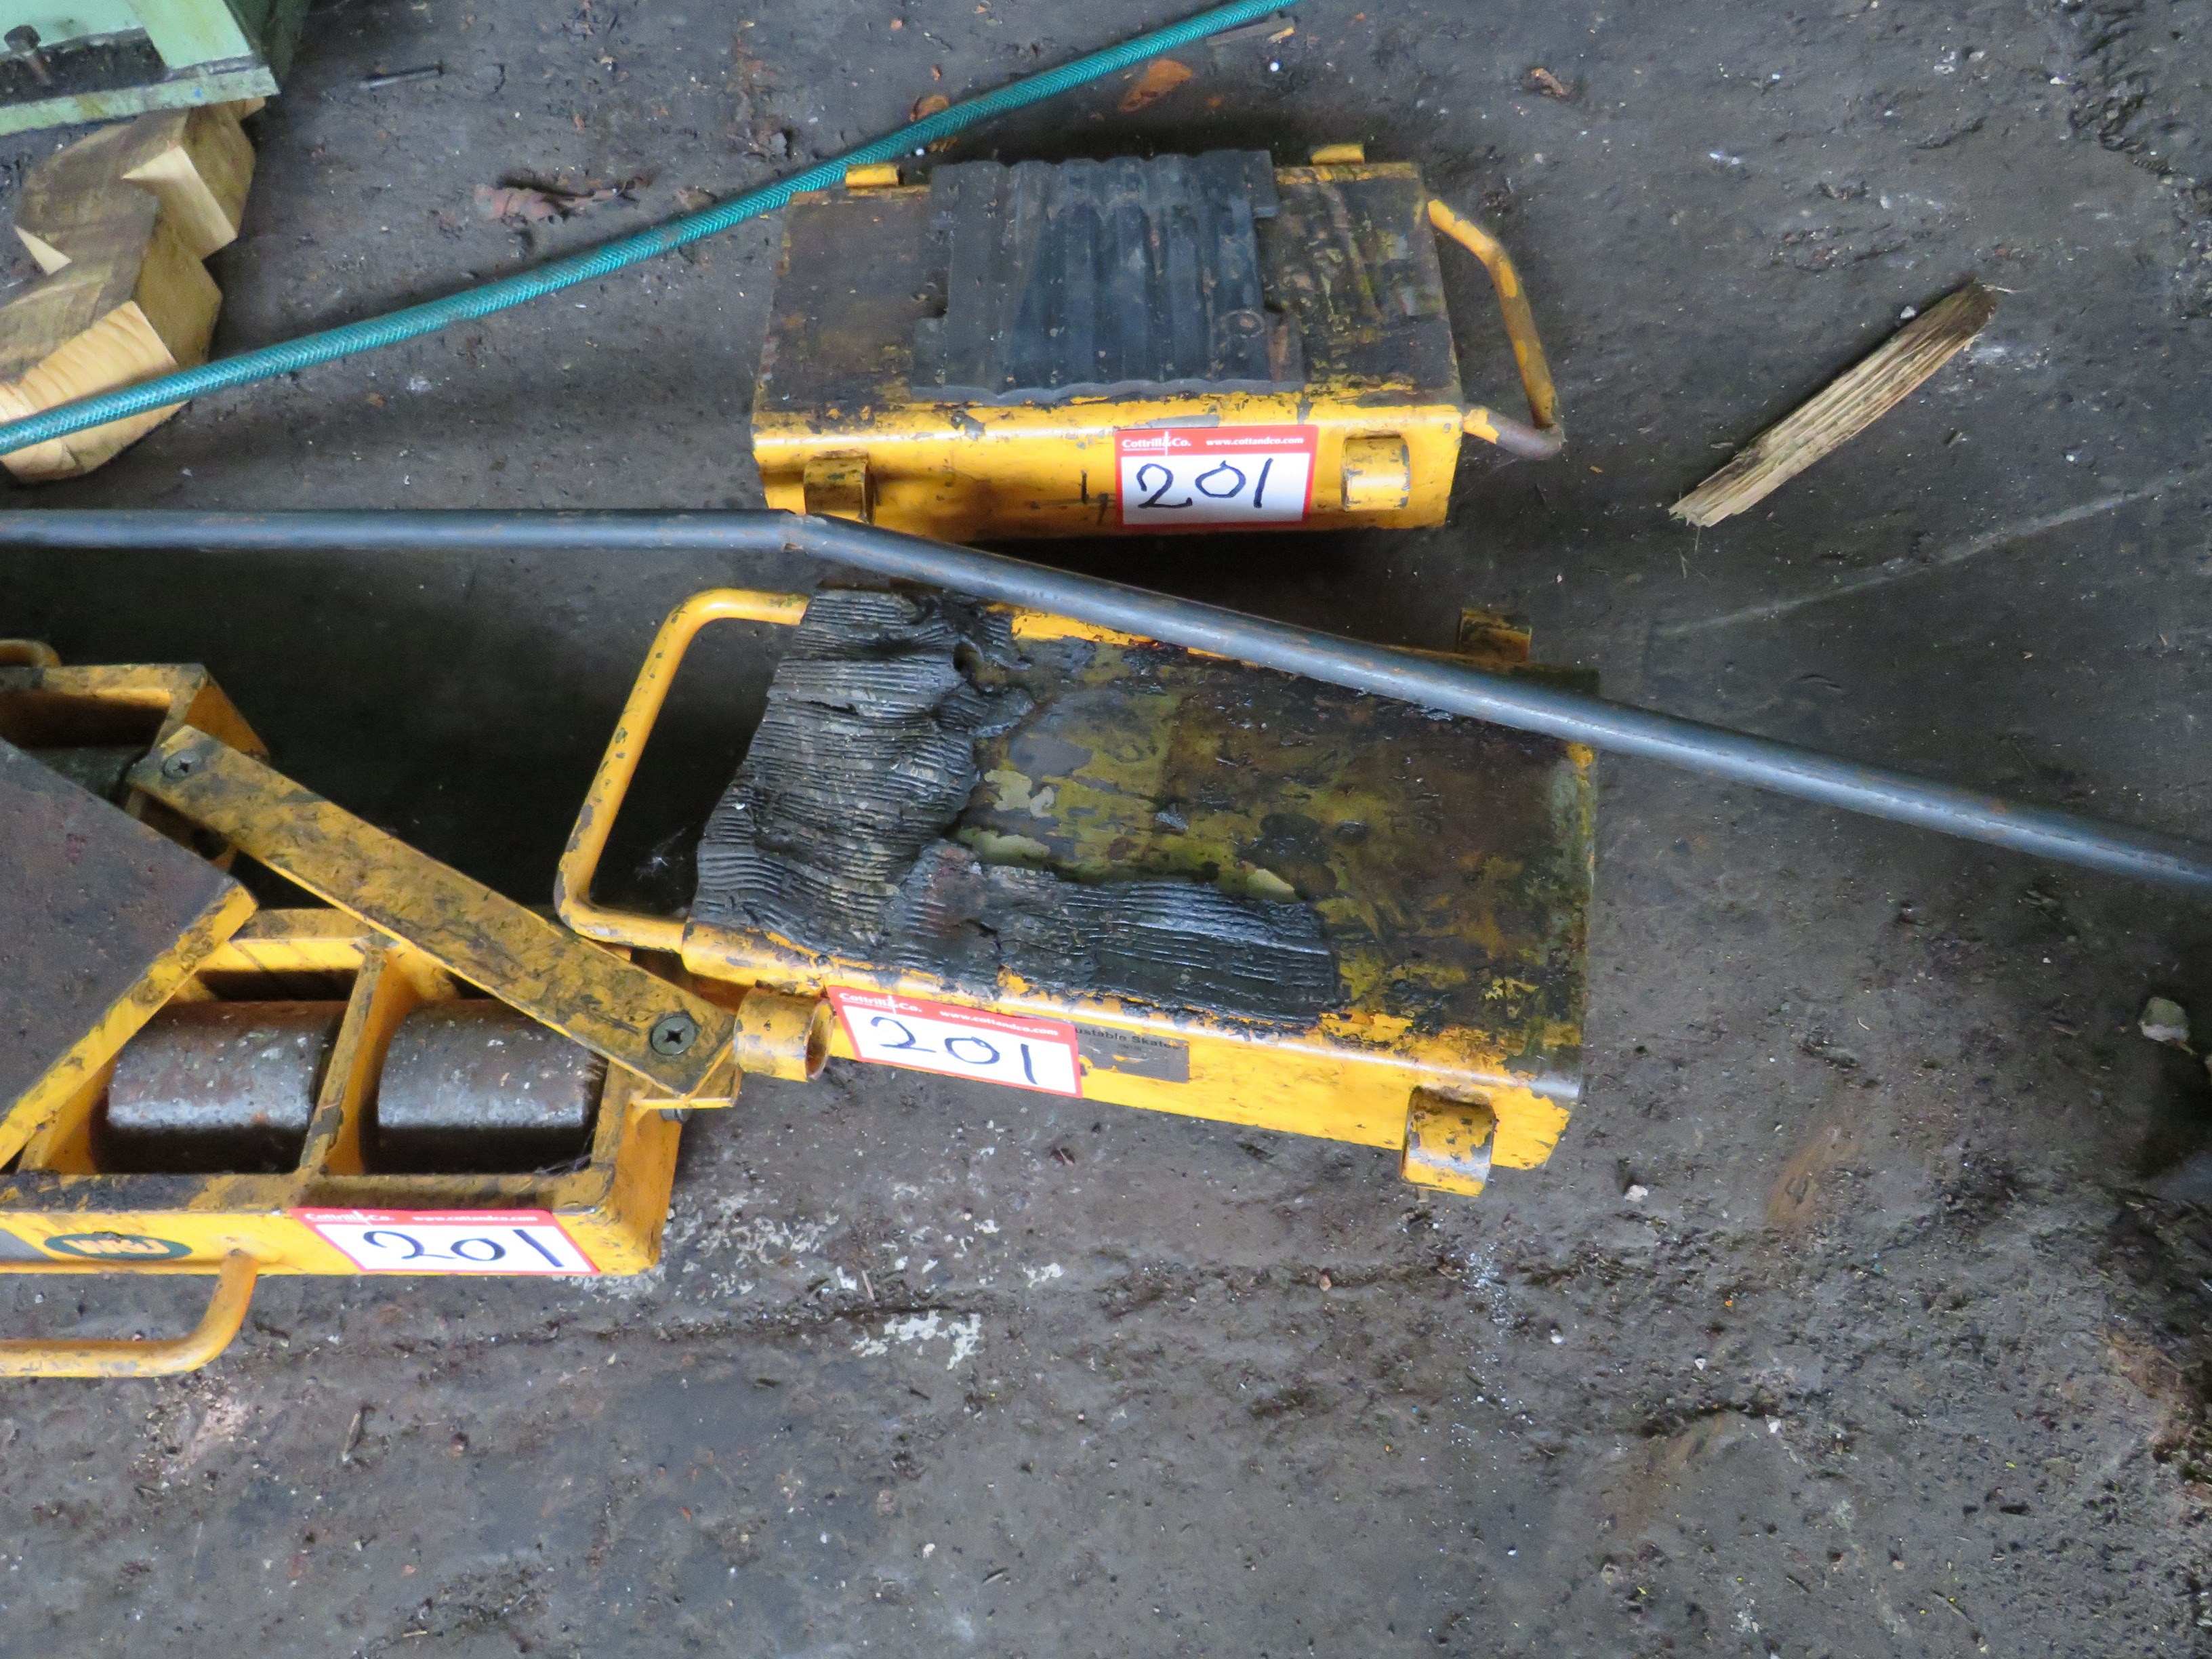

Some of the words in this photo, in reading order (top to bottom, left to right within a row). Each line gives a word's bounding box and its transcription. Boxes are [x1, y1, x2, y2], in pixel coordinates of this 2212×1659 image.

[1122, 436, 1191, 449] Cottrill&Co.
[1206, 436, 1305, 446] www.cottandco.com
[1136, 457, 1274, 509] 201
[940, 1010, 1059, 1036] www.cottandco.com
[1076, 1028, 1128, 1042] ustable
[870, 1016, 1038, 1085] 201
[363, 1229, 565, 1268] 201
